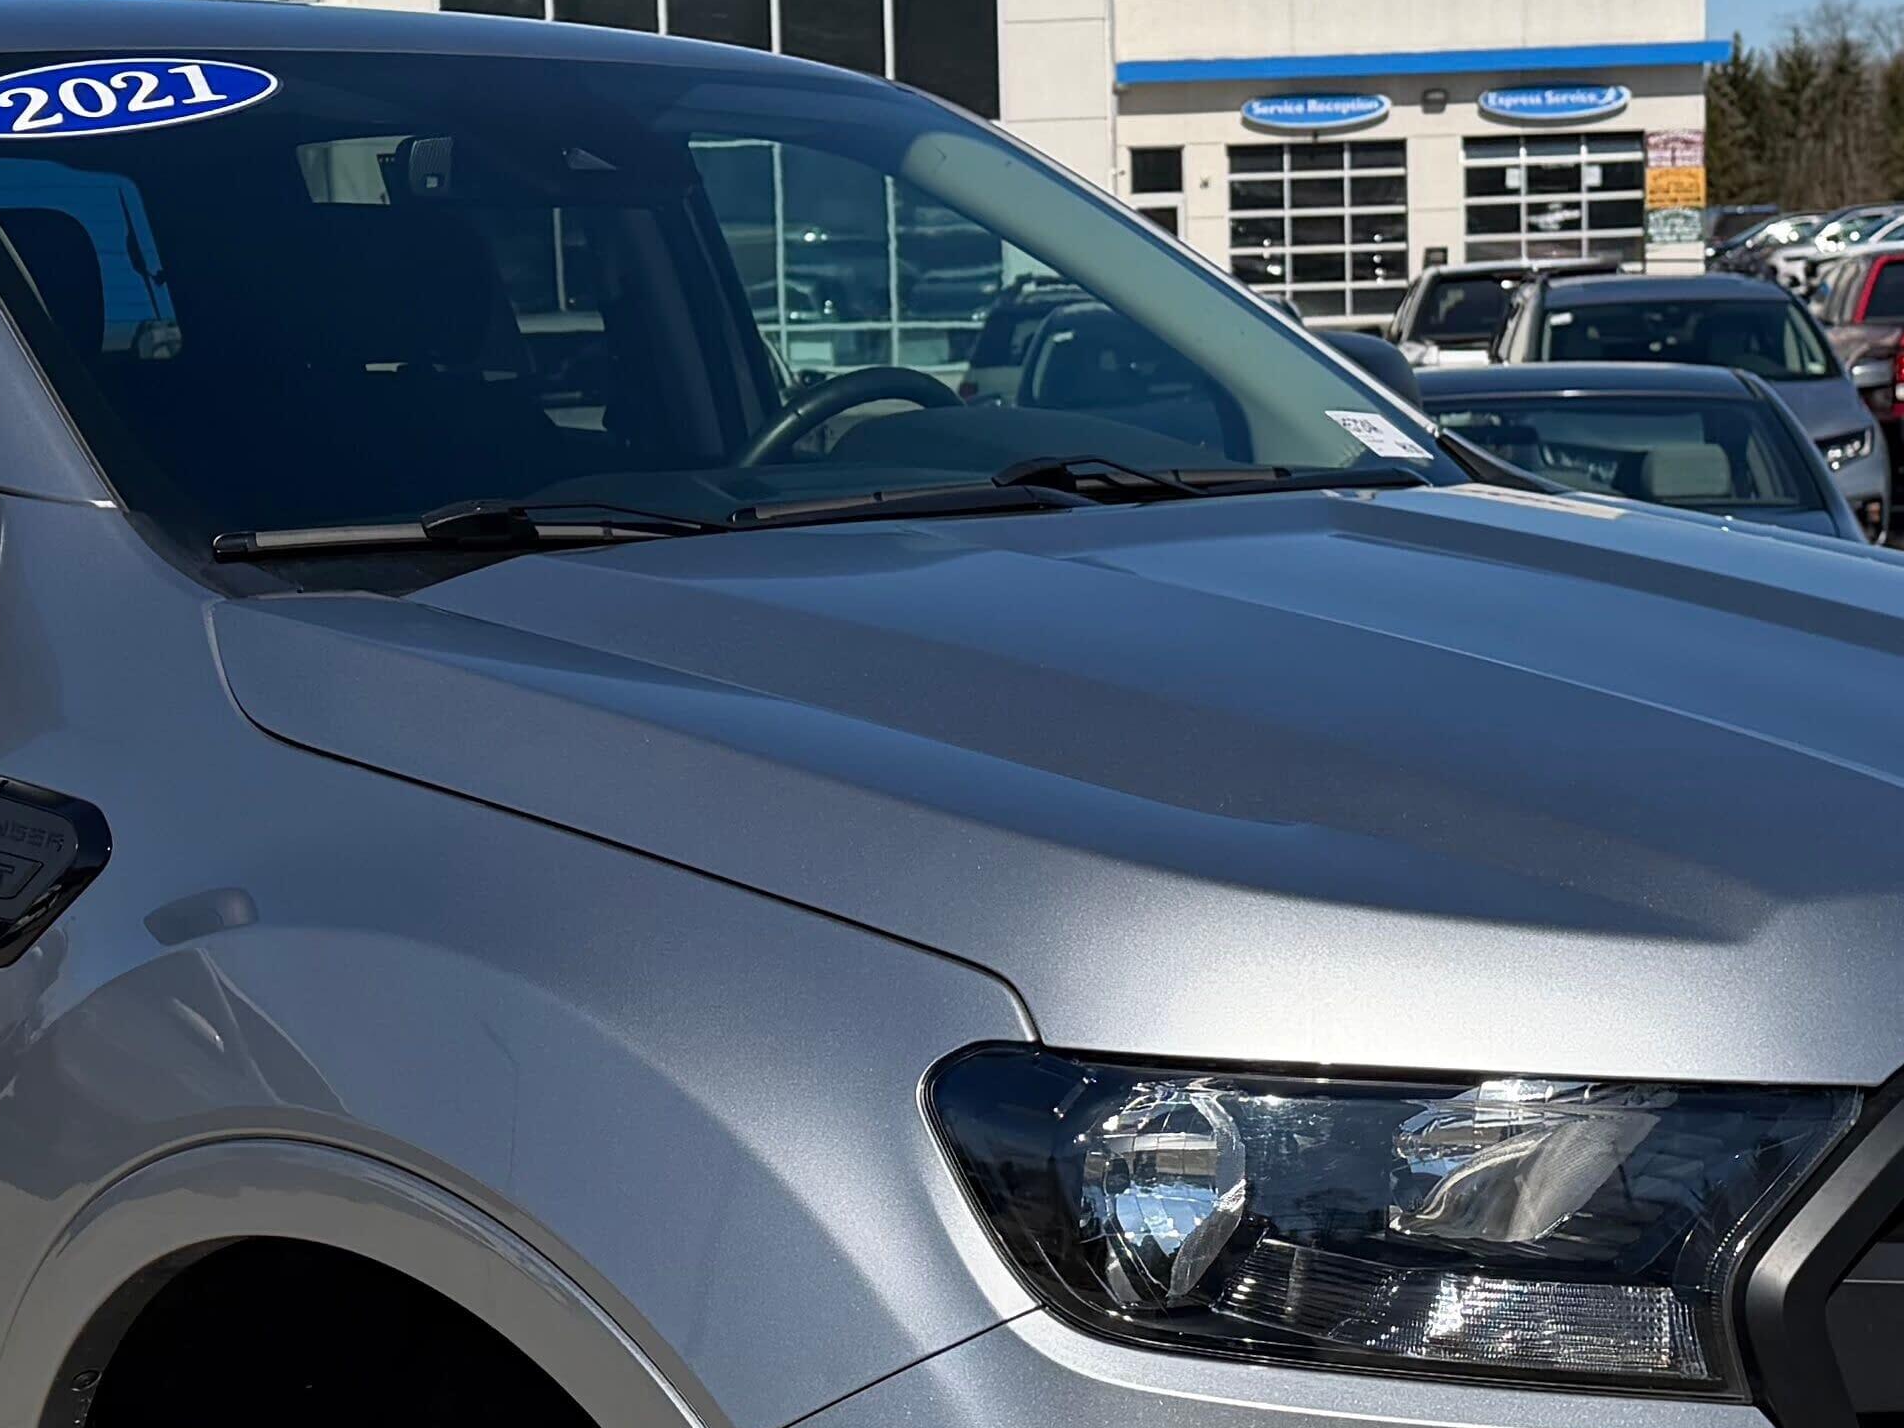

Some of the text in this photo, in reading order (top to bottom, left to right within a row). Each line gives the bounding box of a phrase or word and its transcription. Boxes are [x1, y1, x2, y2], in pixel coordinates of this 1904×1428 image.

[1252, 98, 1380, 115] Service Reception
[1487, 89, 1597, 108] Express Service
